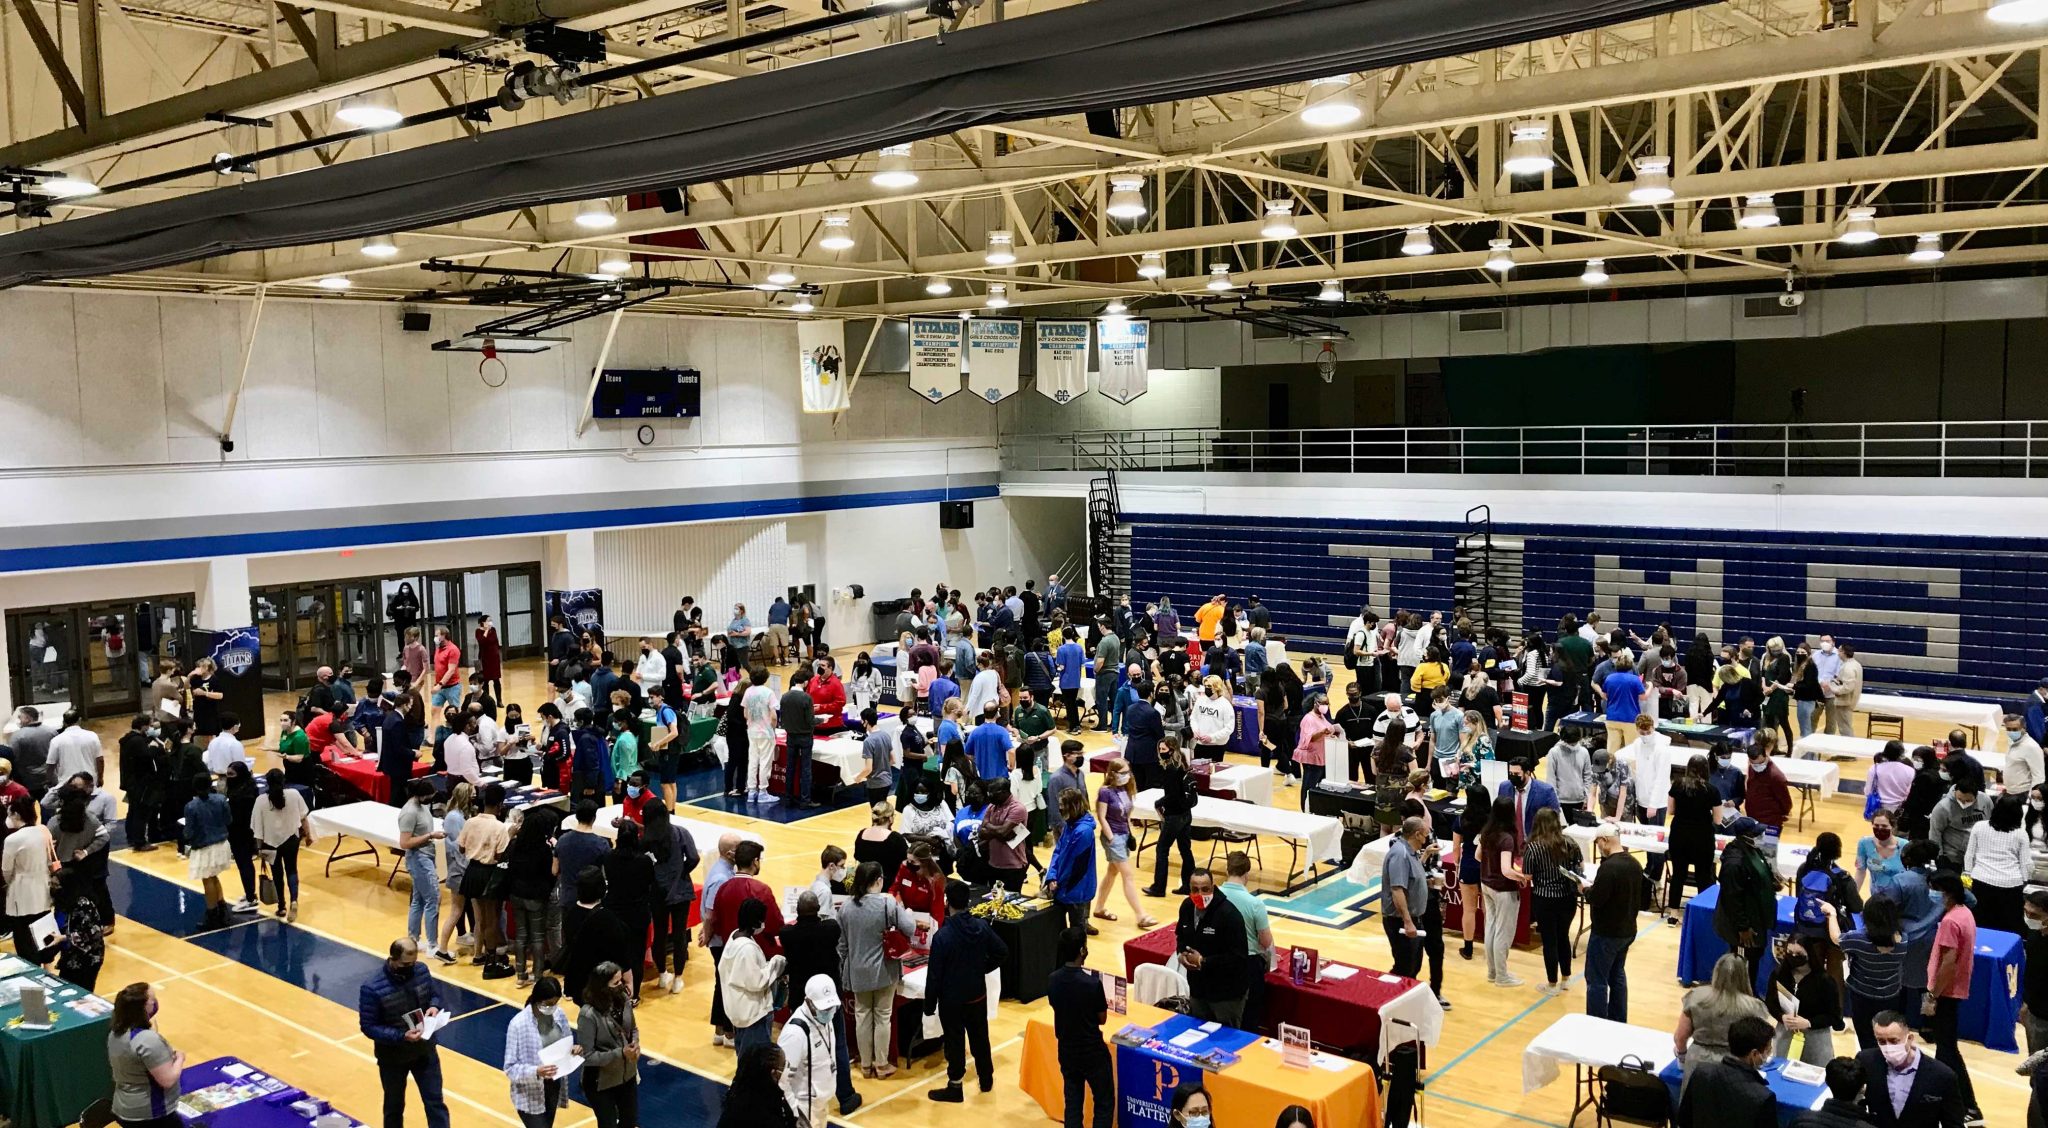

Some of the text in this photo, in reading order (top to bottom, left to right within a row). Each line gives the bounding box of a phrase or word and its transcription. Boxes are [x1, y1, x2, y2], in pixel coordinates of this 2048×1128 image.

[642, 405, 662, 415] period
[222, 651, 252, 668] TITANS
[1199, 705, 1219, 718] NASA
[1961, 813, 1984, 825] PUMA
[1151, 1058, 1180, 1101] P
[1126, 1095, 1158, 1110] UNIVERSITY
